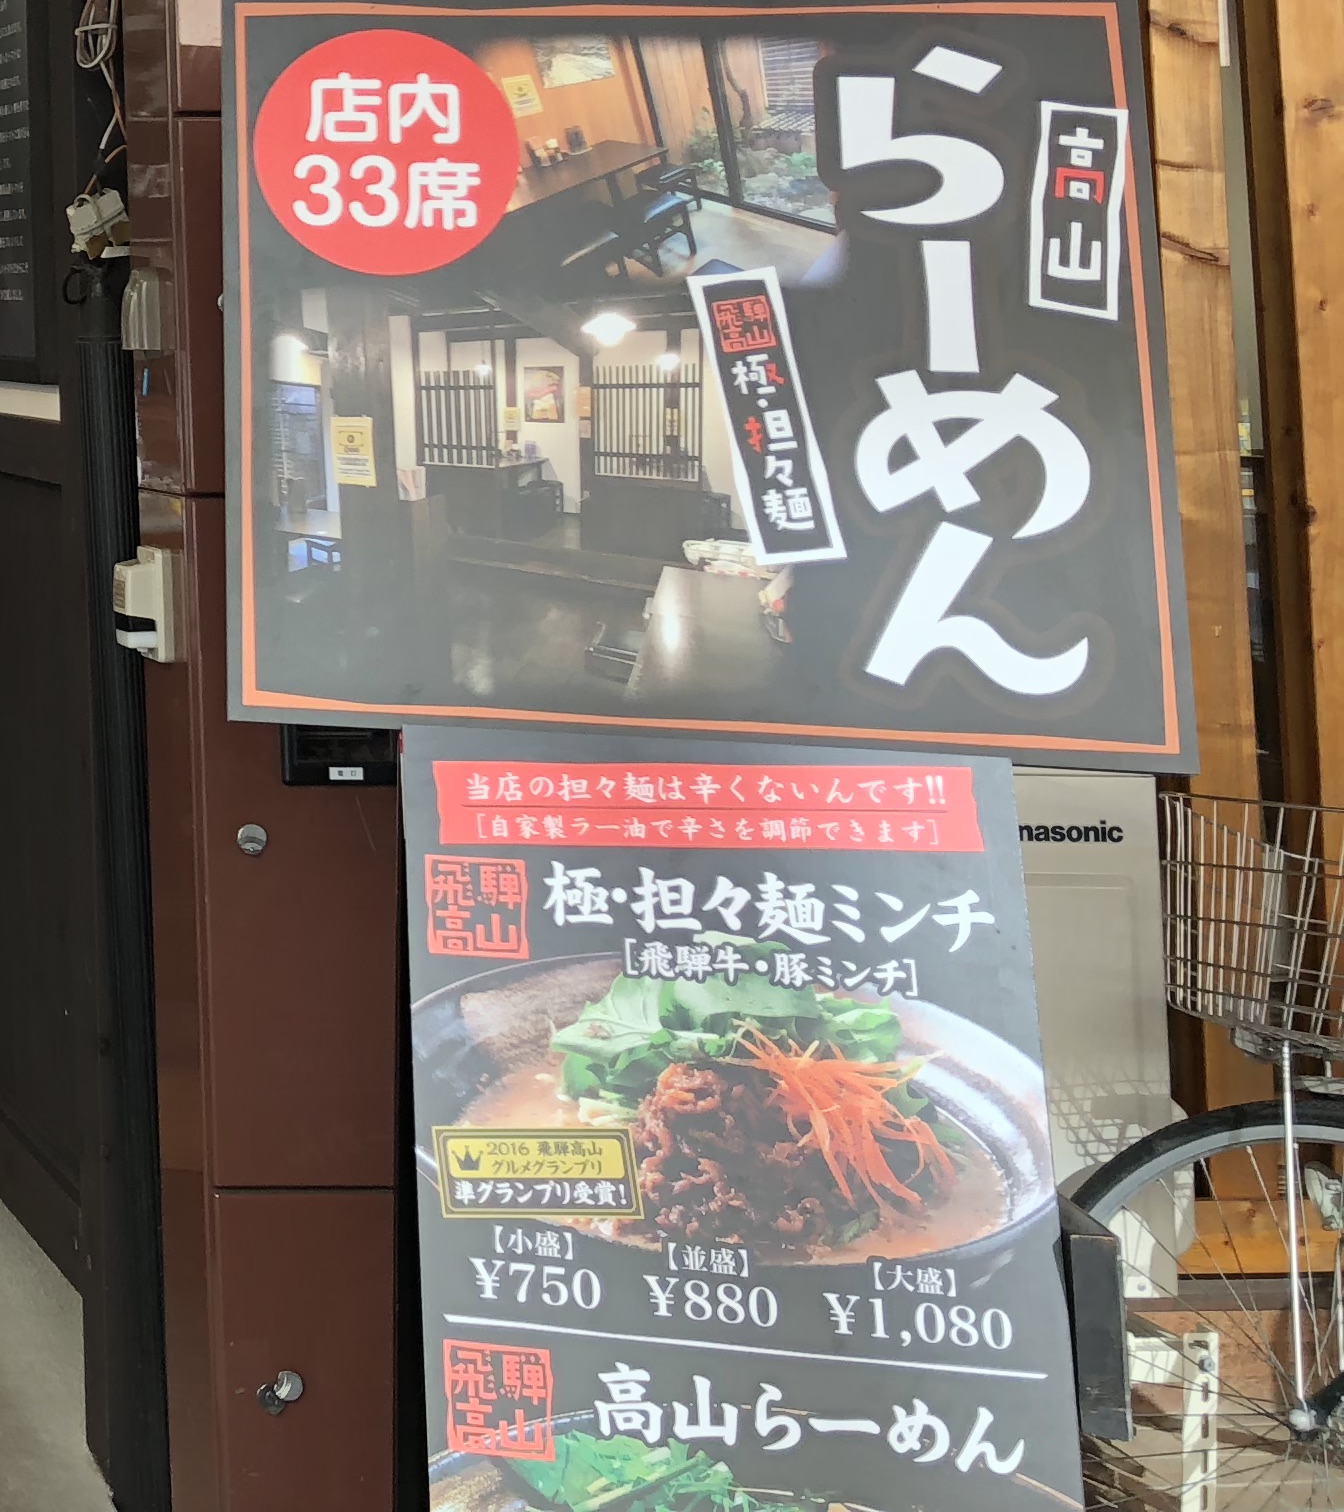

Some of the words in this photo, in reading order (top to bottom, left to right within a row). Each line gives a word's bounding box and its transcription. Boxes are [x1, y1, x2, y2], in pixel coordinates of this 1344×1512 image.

[305, 74, 461, 144] 店内
[292, 154, 481, 232] 33席
[1048, 127, 1104, 283] 高山
[836, 44, 1092, 697] らーめん
[464, 772, 948, 806] 当店の担々麺は辛くないんです!!
[1018, 820, 1124, 842] nasonic
[543, 861, 995, 953] 極・担々麺ミンチ
[486, 1141, 531, 1156] 2016
[490, 1158, 603, 1176] グルメグランプリ
[469, 1256, 602, 1310] ¥750
[643, 1273, 779, 1328] ¥880
[823, 1291, 1013, 1350] ¥1,080
[594, 1361, 1025, 1474] 高山らーめん
